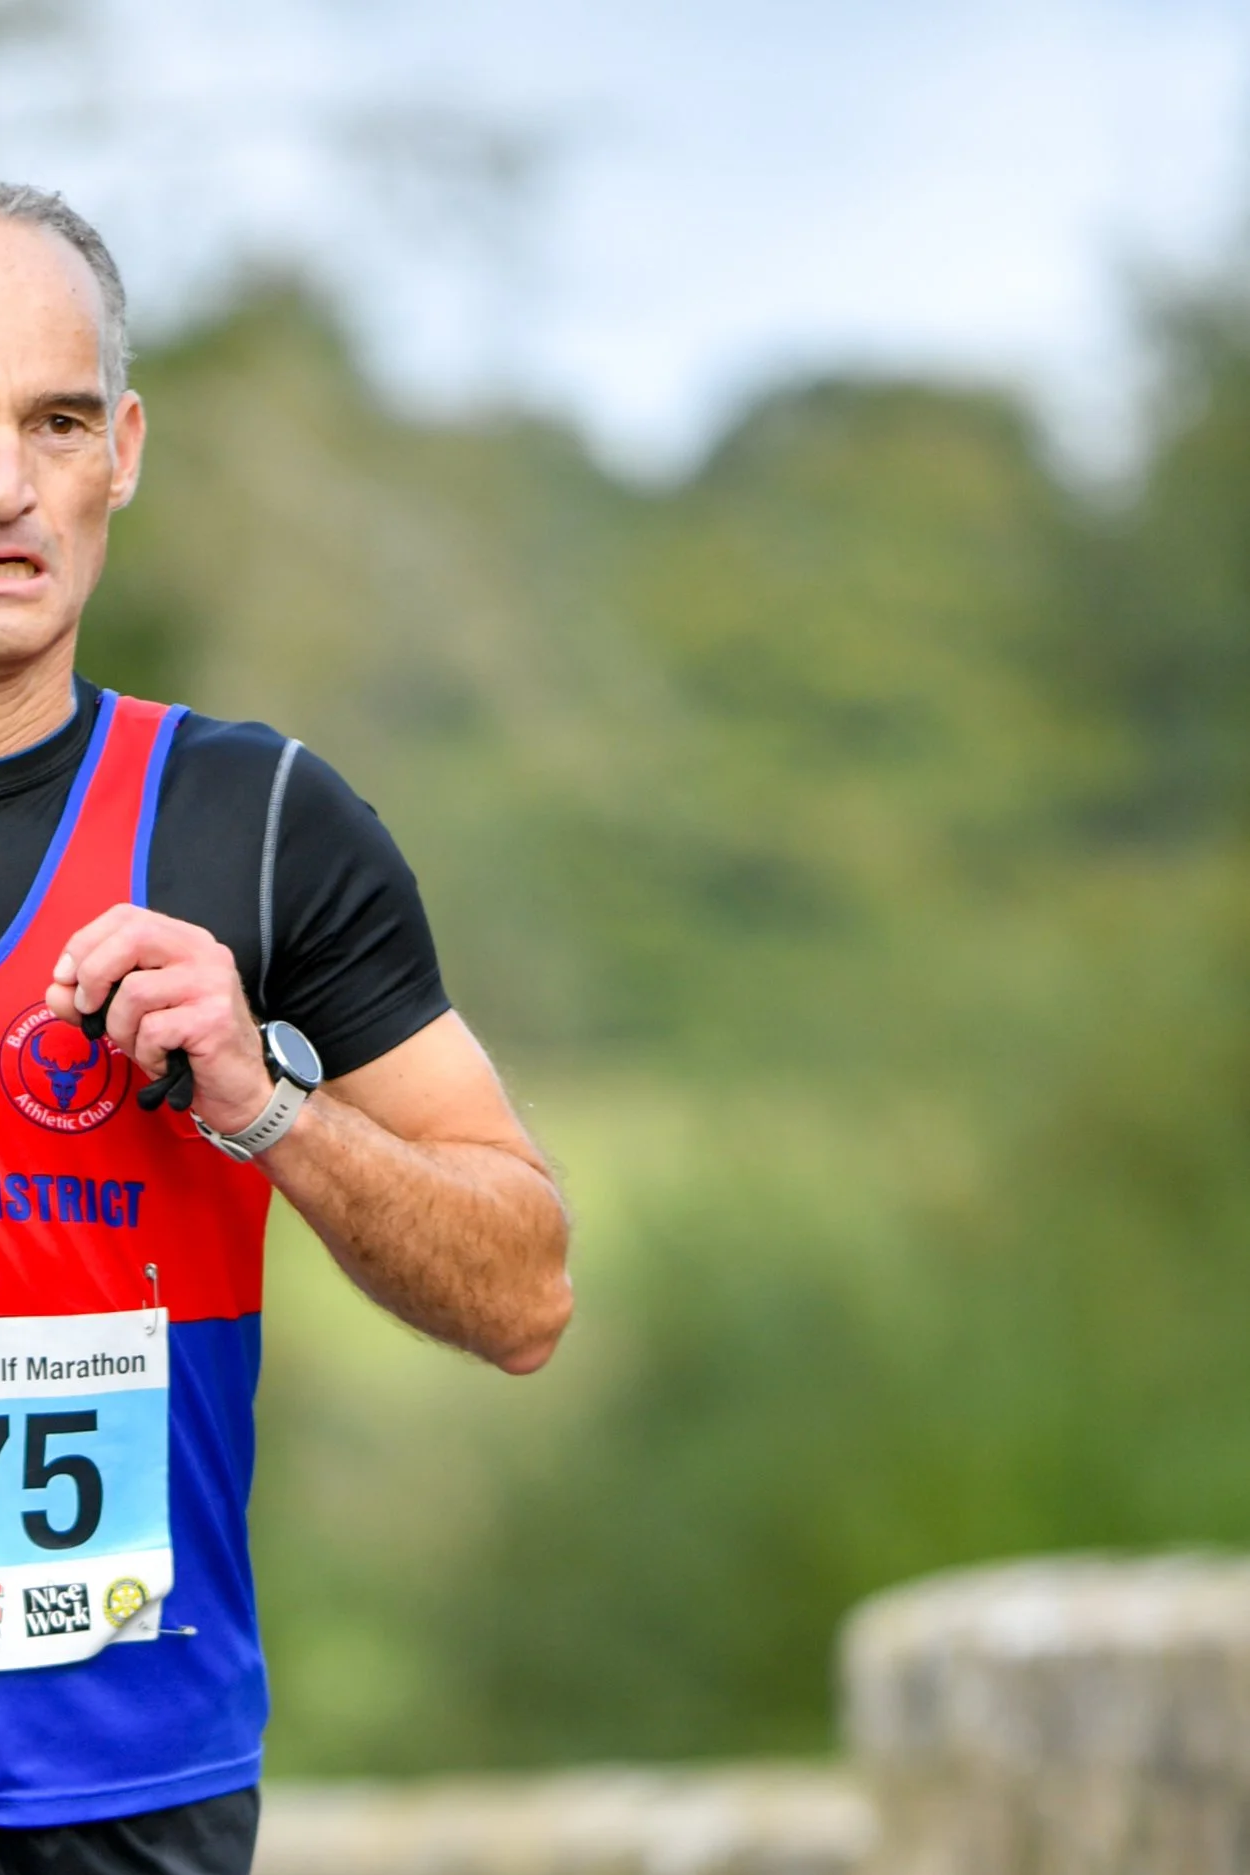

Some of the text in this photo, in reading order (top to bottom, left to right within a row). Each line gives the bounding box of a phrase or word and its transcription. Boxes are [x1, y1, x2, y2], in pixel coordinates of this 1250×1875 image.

[15, 1093, 114, 1130] Athletic Club
[26, 1352, 146, 1381] Marathon
